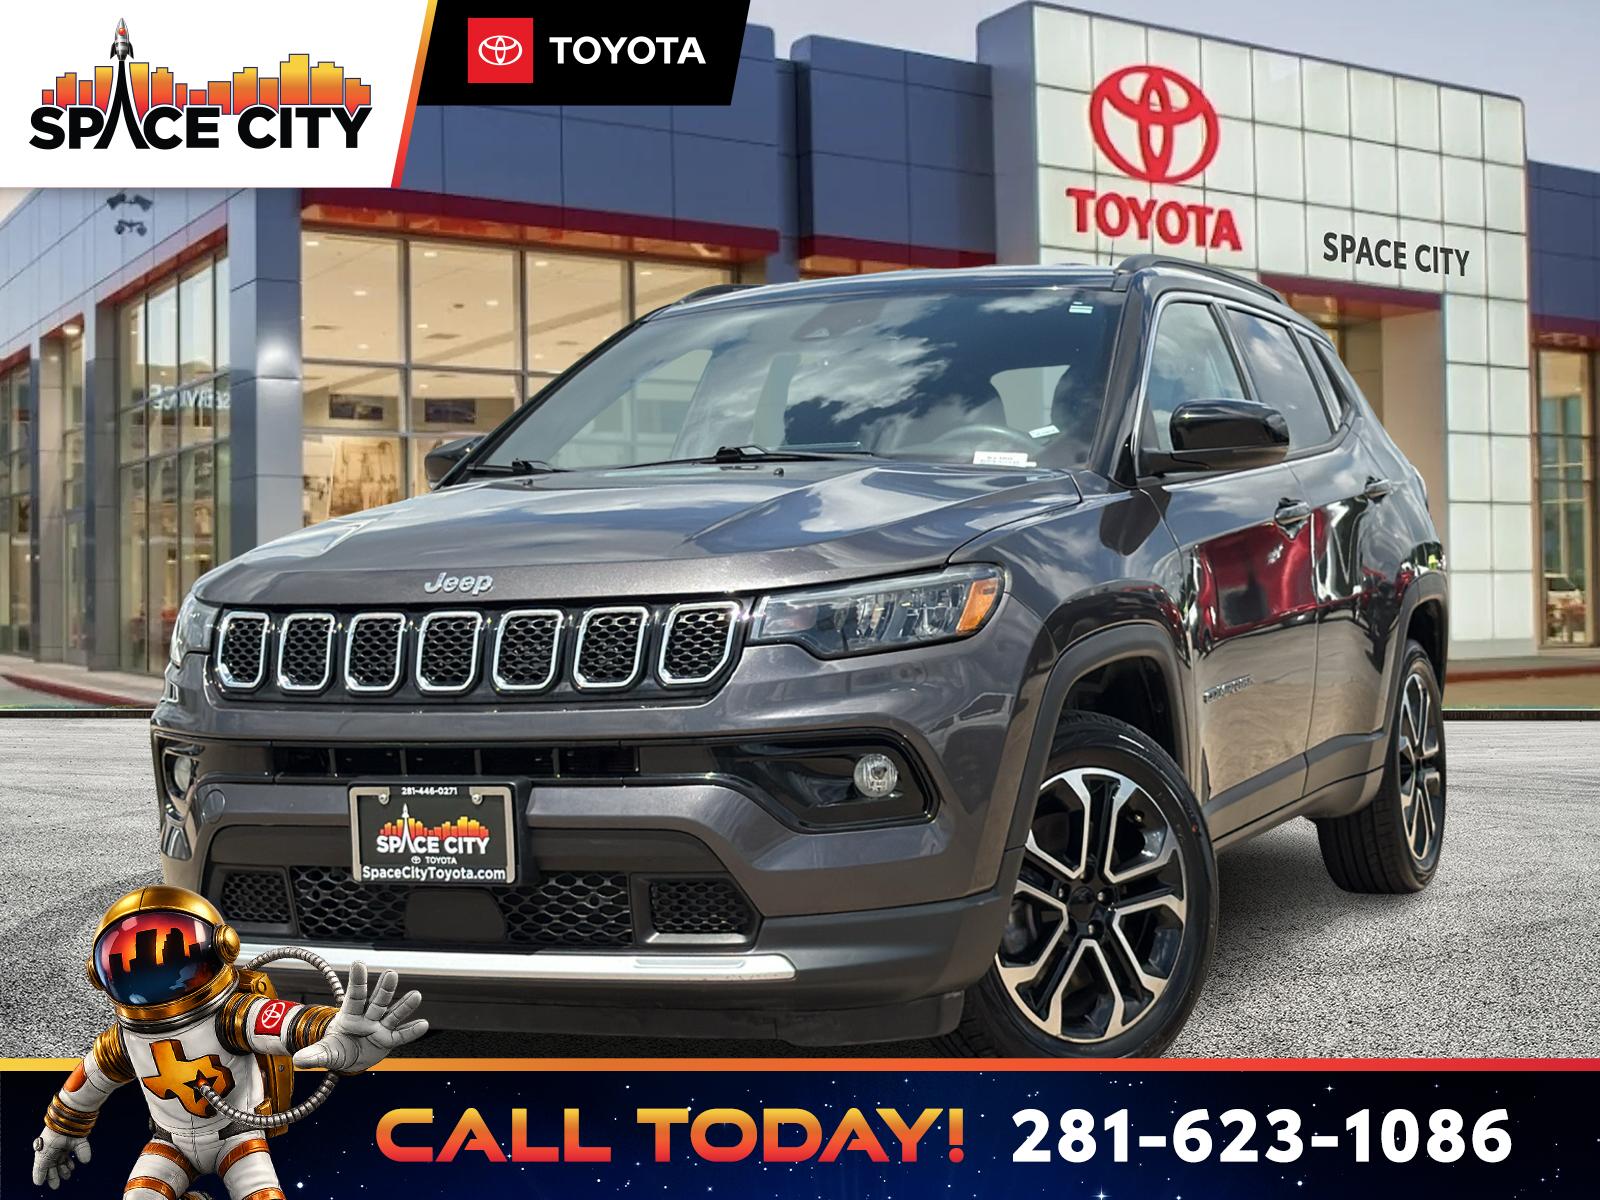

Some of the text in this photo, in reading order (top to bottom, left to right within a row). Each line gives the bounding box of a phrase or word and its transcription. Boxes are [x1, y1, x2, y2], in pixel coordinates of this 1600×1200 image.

[1066, 188, 1242, 251] TOYOTA
[1322, 231, 1471, 277] SPACE CITY
[424, 572, 493, 596] Jeep
[401, 786, 458, 796] 281-446-0271
[376, 832, 490, 855] SPACE CITY
[425, 856, 457, 865] TOYOTA
[362, 865, 506, 882] SpaceCityToyota.com
